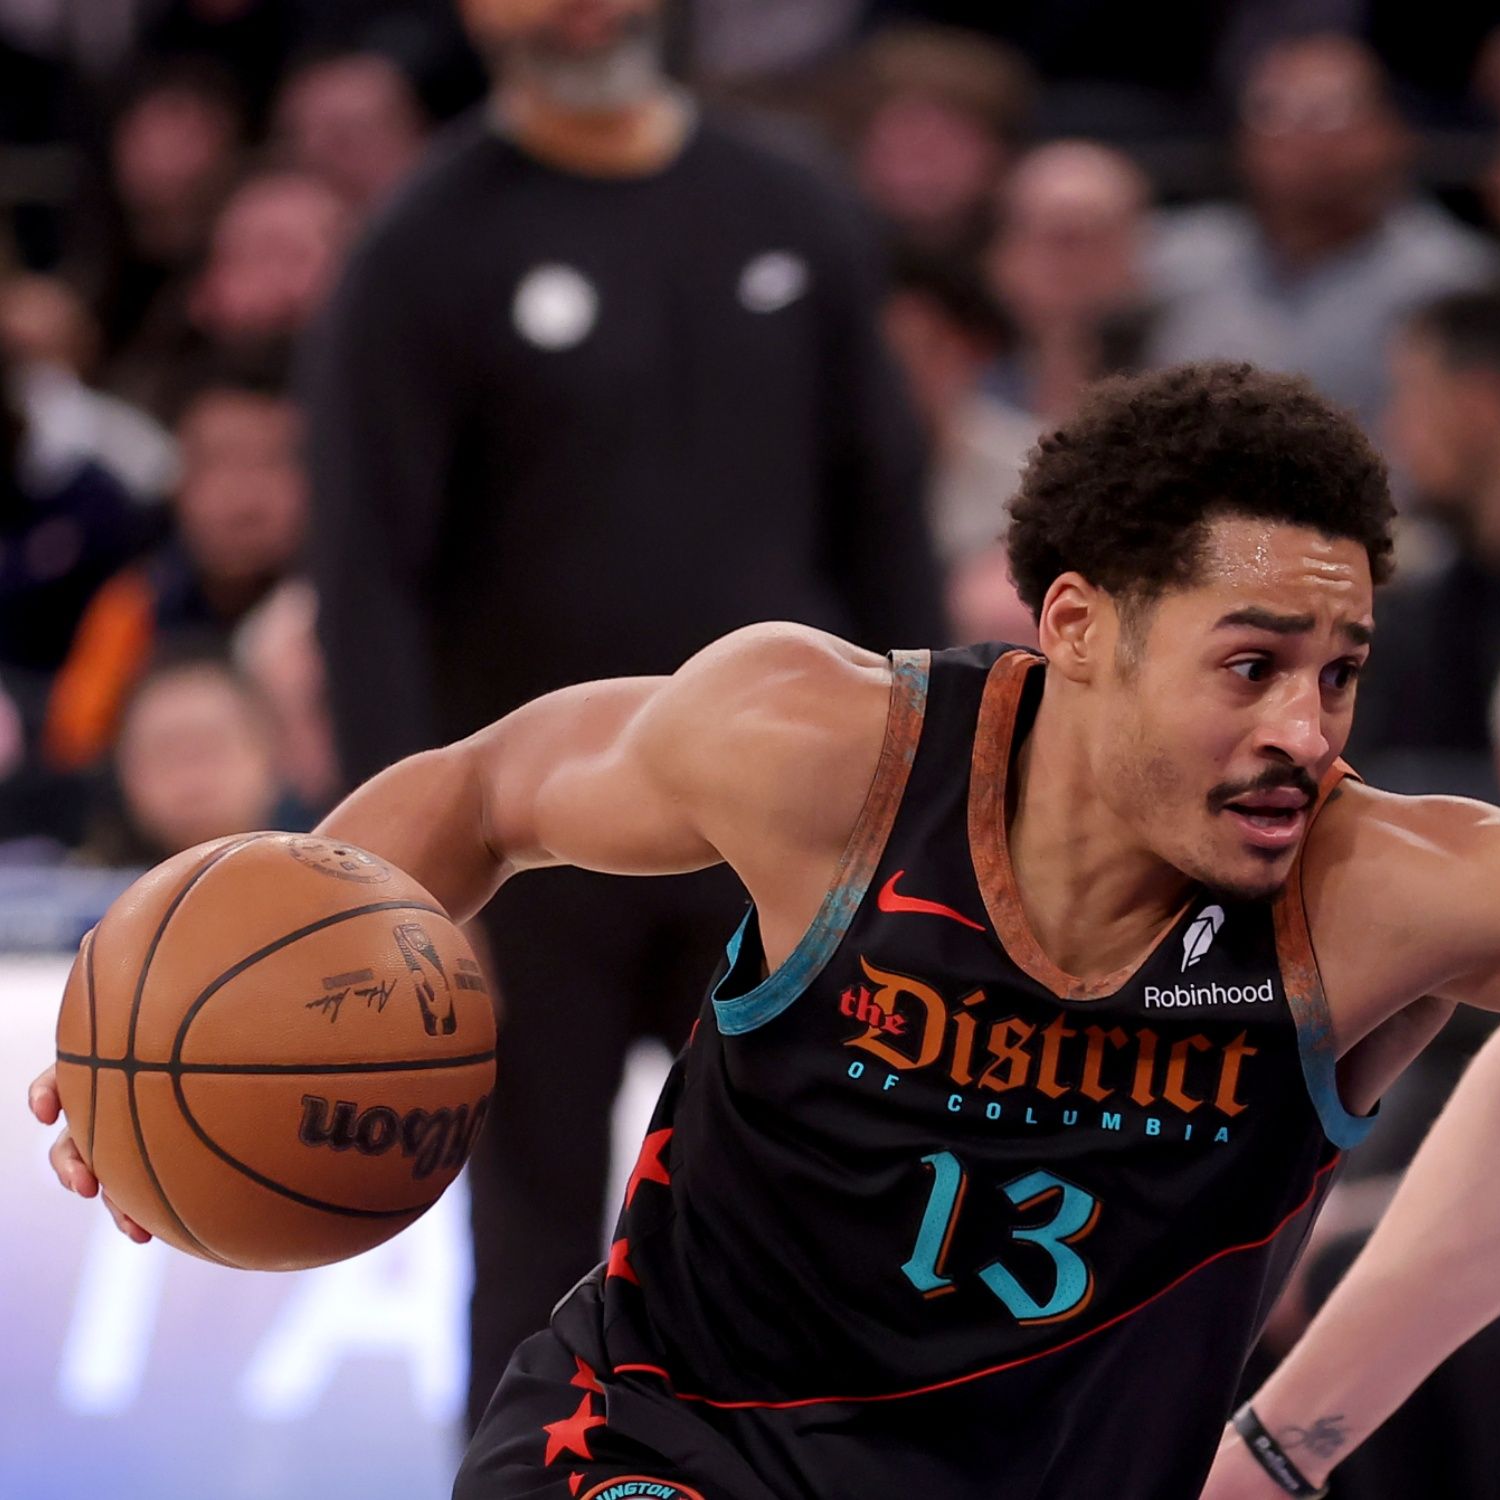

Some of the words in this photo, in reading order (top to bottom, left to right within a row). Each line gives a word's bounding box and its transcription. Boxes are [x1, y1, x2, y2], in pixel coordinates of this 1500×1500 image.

[838, 986, 907, 1036] the
[1143, 978, 1274, 1009] Robinhood
[843, 954, 1259, 1117] District
[847, 1060, 900, 1092] OF
[947, 1093, 1230, 1143] COLUMBIA
[900, 1150, 1104, 1326] 13
[595, 1482, 676, 1500] INGTON
